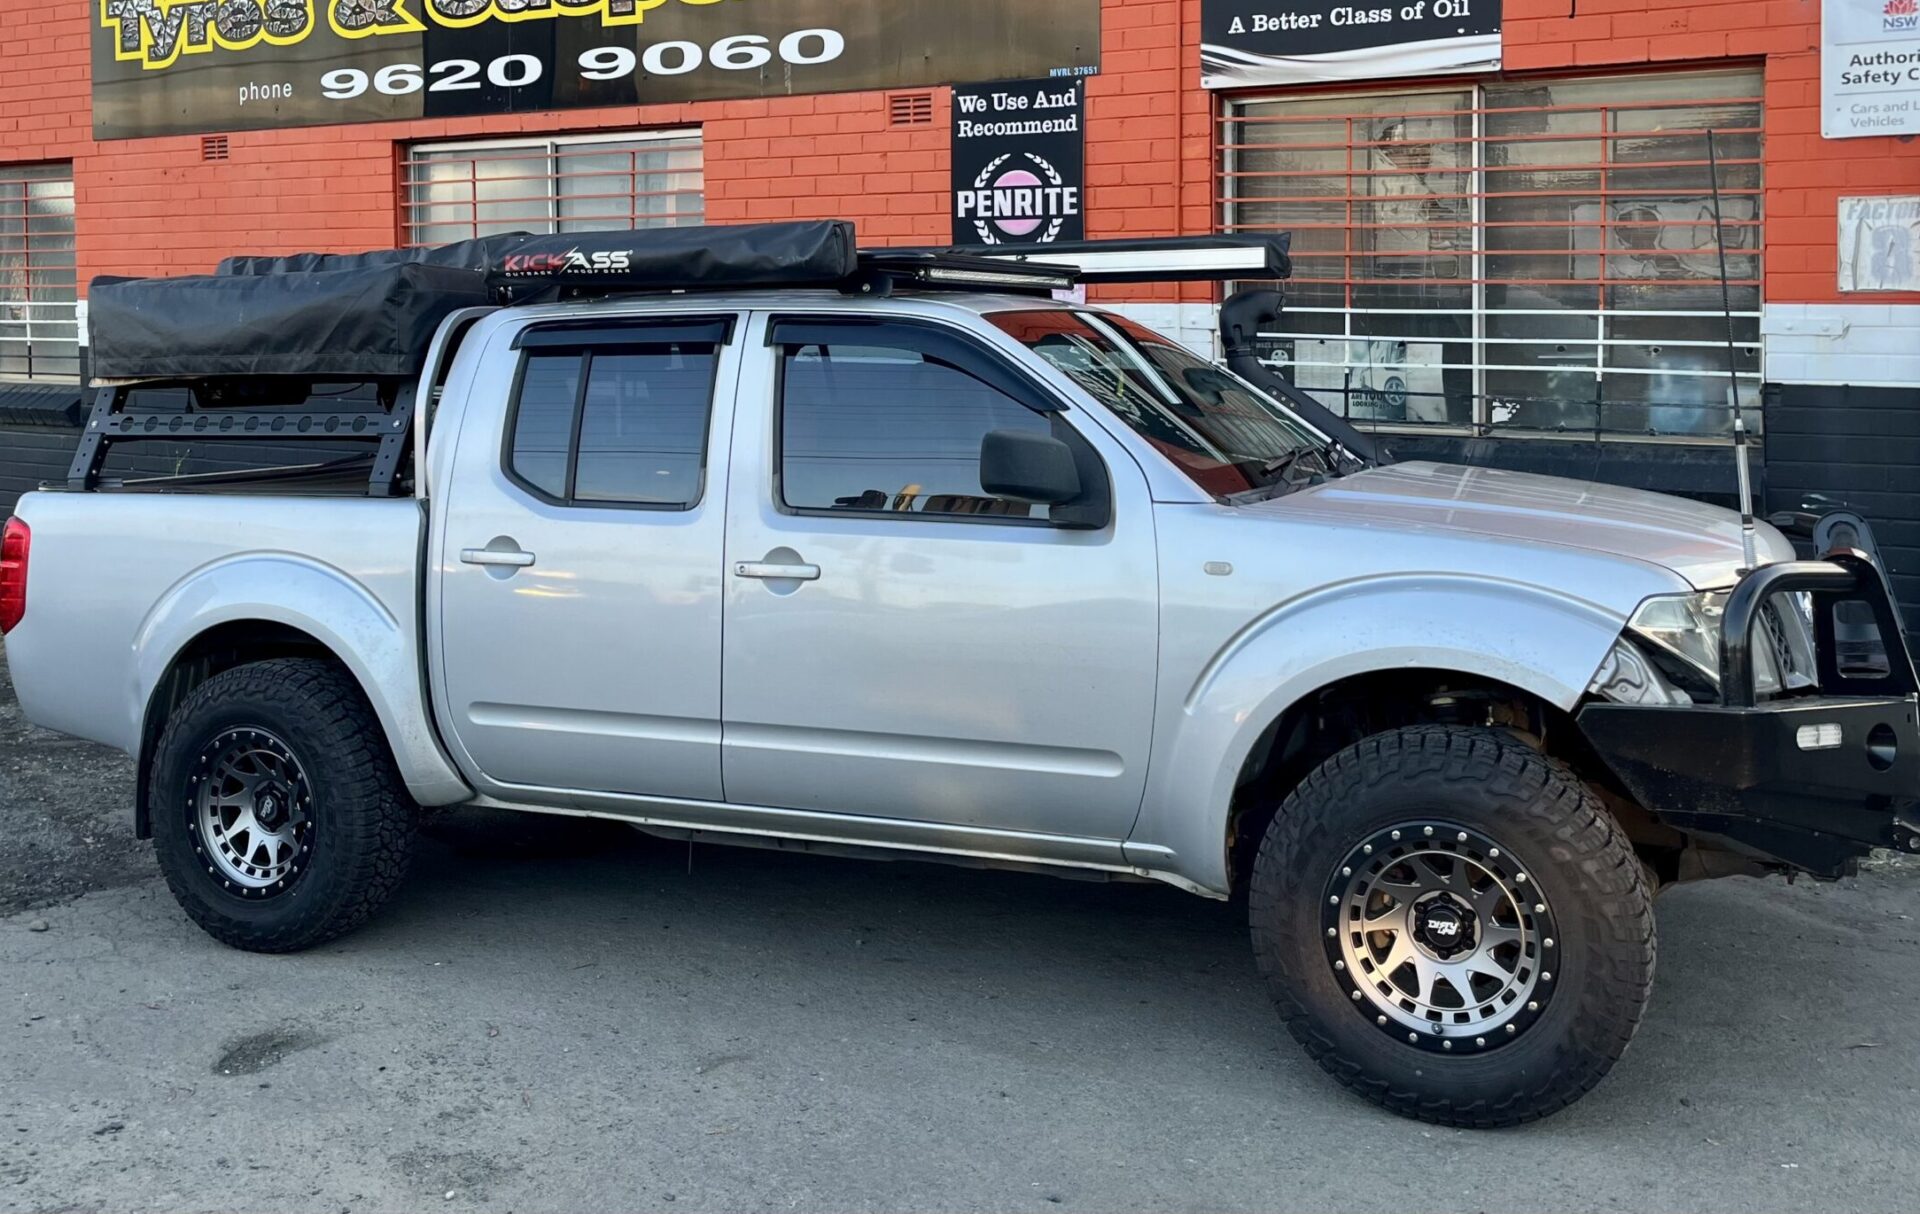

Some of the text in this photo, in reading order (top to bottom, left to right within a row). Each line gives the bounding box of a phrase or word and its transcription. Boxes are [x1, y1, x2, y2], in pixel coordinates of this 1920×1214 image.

[1228, 0, 1470, 34] A Better Class of Oil
[1882, 15, 1918, 29] NSW
[239, 28, 845, 105] phone 9620 9060
[1049, 66, 1098, 77] MVRL 37651
[1841, 69, 1902, 86] Safety
[957, 88, 1078, 113] We Use And
[1850, 103, 1879, 115] Cars
[1883, 100, 1909, 113] and
[957, 114, 1078, 138] Recommend
[1850, 115, 1905, 128] Vehicles
[957, 186, 1078, 218] PENRITE
